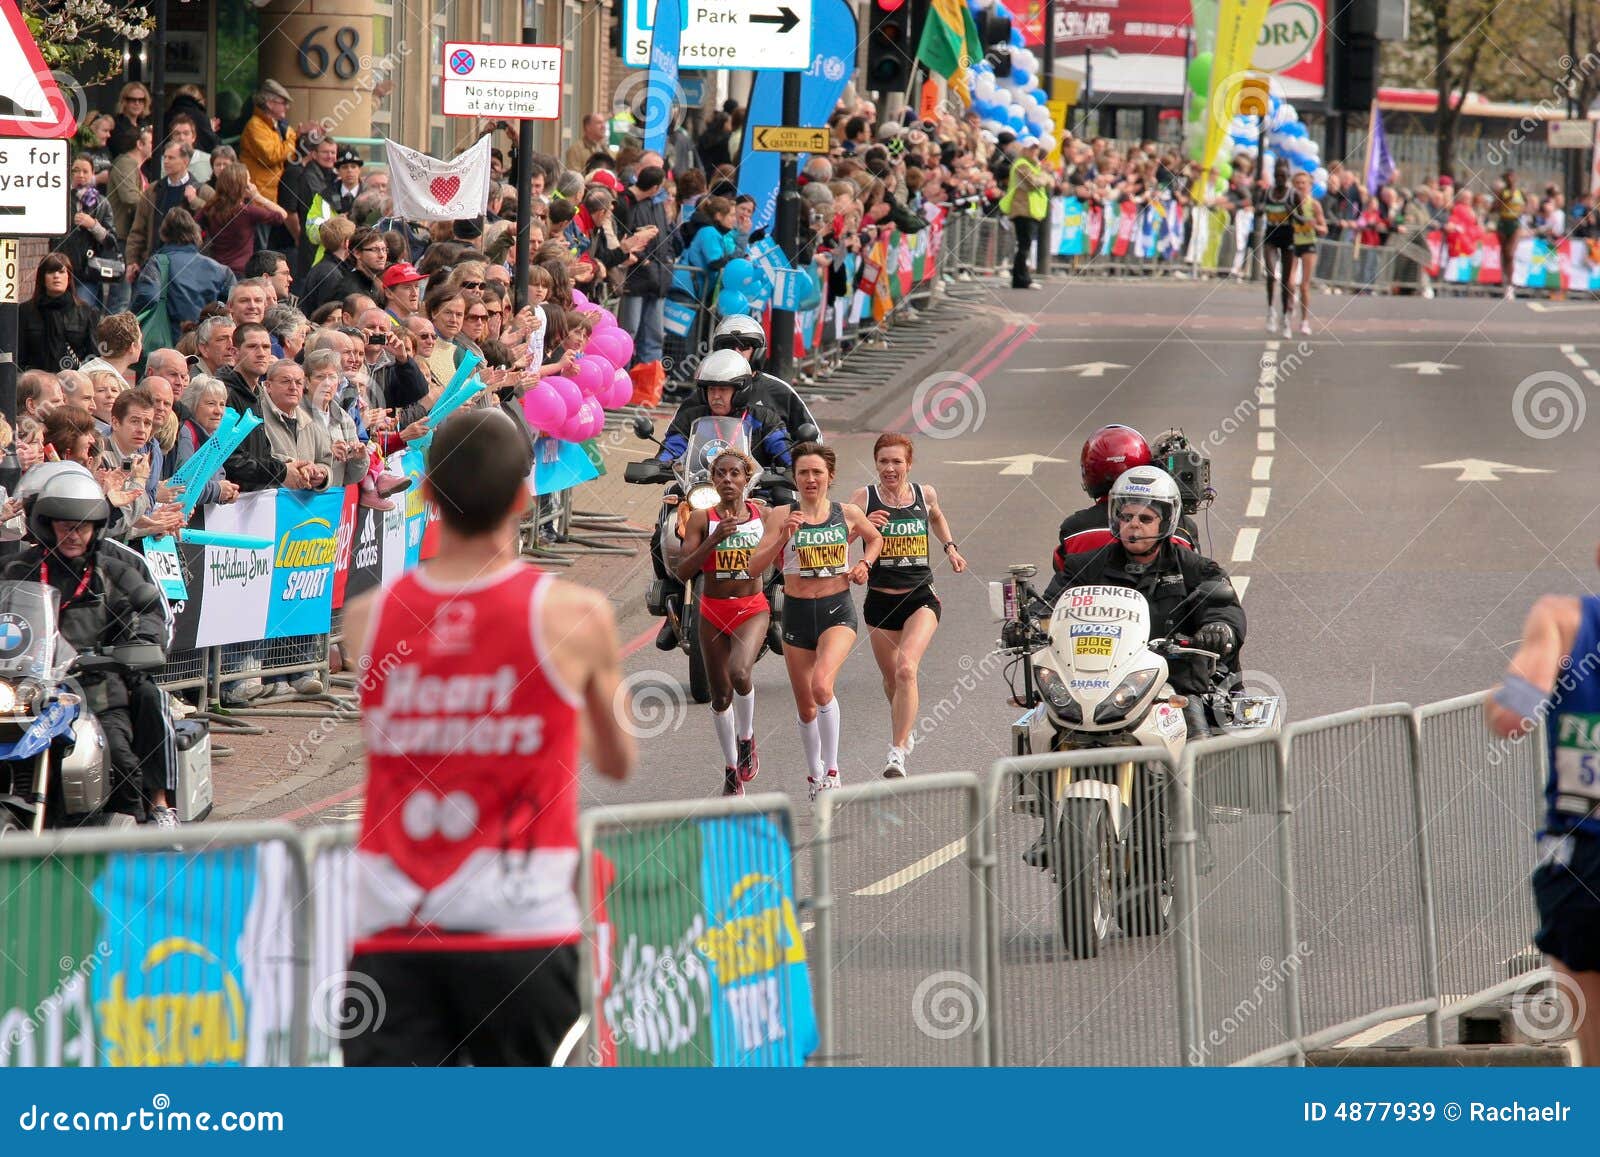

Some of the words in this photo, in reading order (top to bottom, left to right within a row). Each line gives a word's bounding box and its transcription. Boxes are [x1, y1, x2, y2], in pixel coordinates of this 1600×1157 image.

[697, 8, 738, 24] Park
[1256, 21, 1308, 46] ORA
[297, 25, 360, 80] 68
[636, 40, 736, 58] Srstore
[480, 58, 507, 69] RED
[512, 60, 557, 71] ROUTE
[465, 86, 483, 96] No
[487, 88, 539, 100] stopping
[468, 100, 479, 109] at
[484, 102, 505, 112] any
[509, 101, 535, 112] time
[29, 147, 61, 165] for
[0, 171, 61, 190] yards
[881, 519, 925, 535] FLORA
[797, 530, 844, 545] FLORA
[355, 541, 378, 569] adidas
[881, 537, 926, 556] ZAKHAROVA
[797, 545, 845, 568] MIKITENKO
[210, 550, 247, 588] Holiday
[249, 550, 269, 580] Inn
[282, 567, 331, 600] SPORT
[1064, 587, 1142, 601] SCHENKER
[1071, 595, 1093, 607] DB
[1054, 605, 1140, 623] TRIUMPH
[1072, 624, 1120, 635] WOODS
[1077, 636, 1112, 647] BBC
[1075, 647, 1111, 655] SPORT
[384, 664, 516, 714] Heart
[1070, 679, 1110, 689] SHARK
